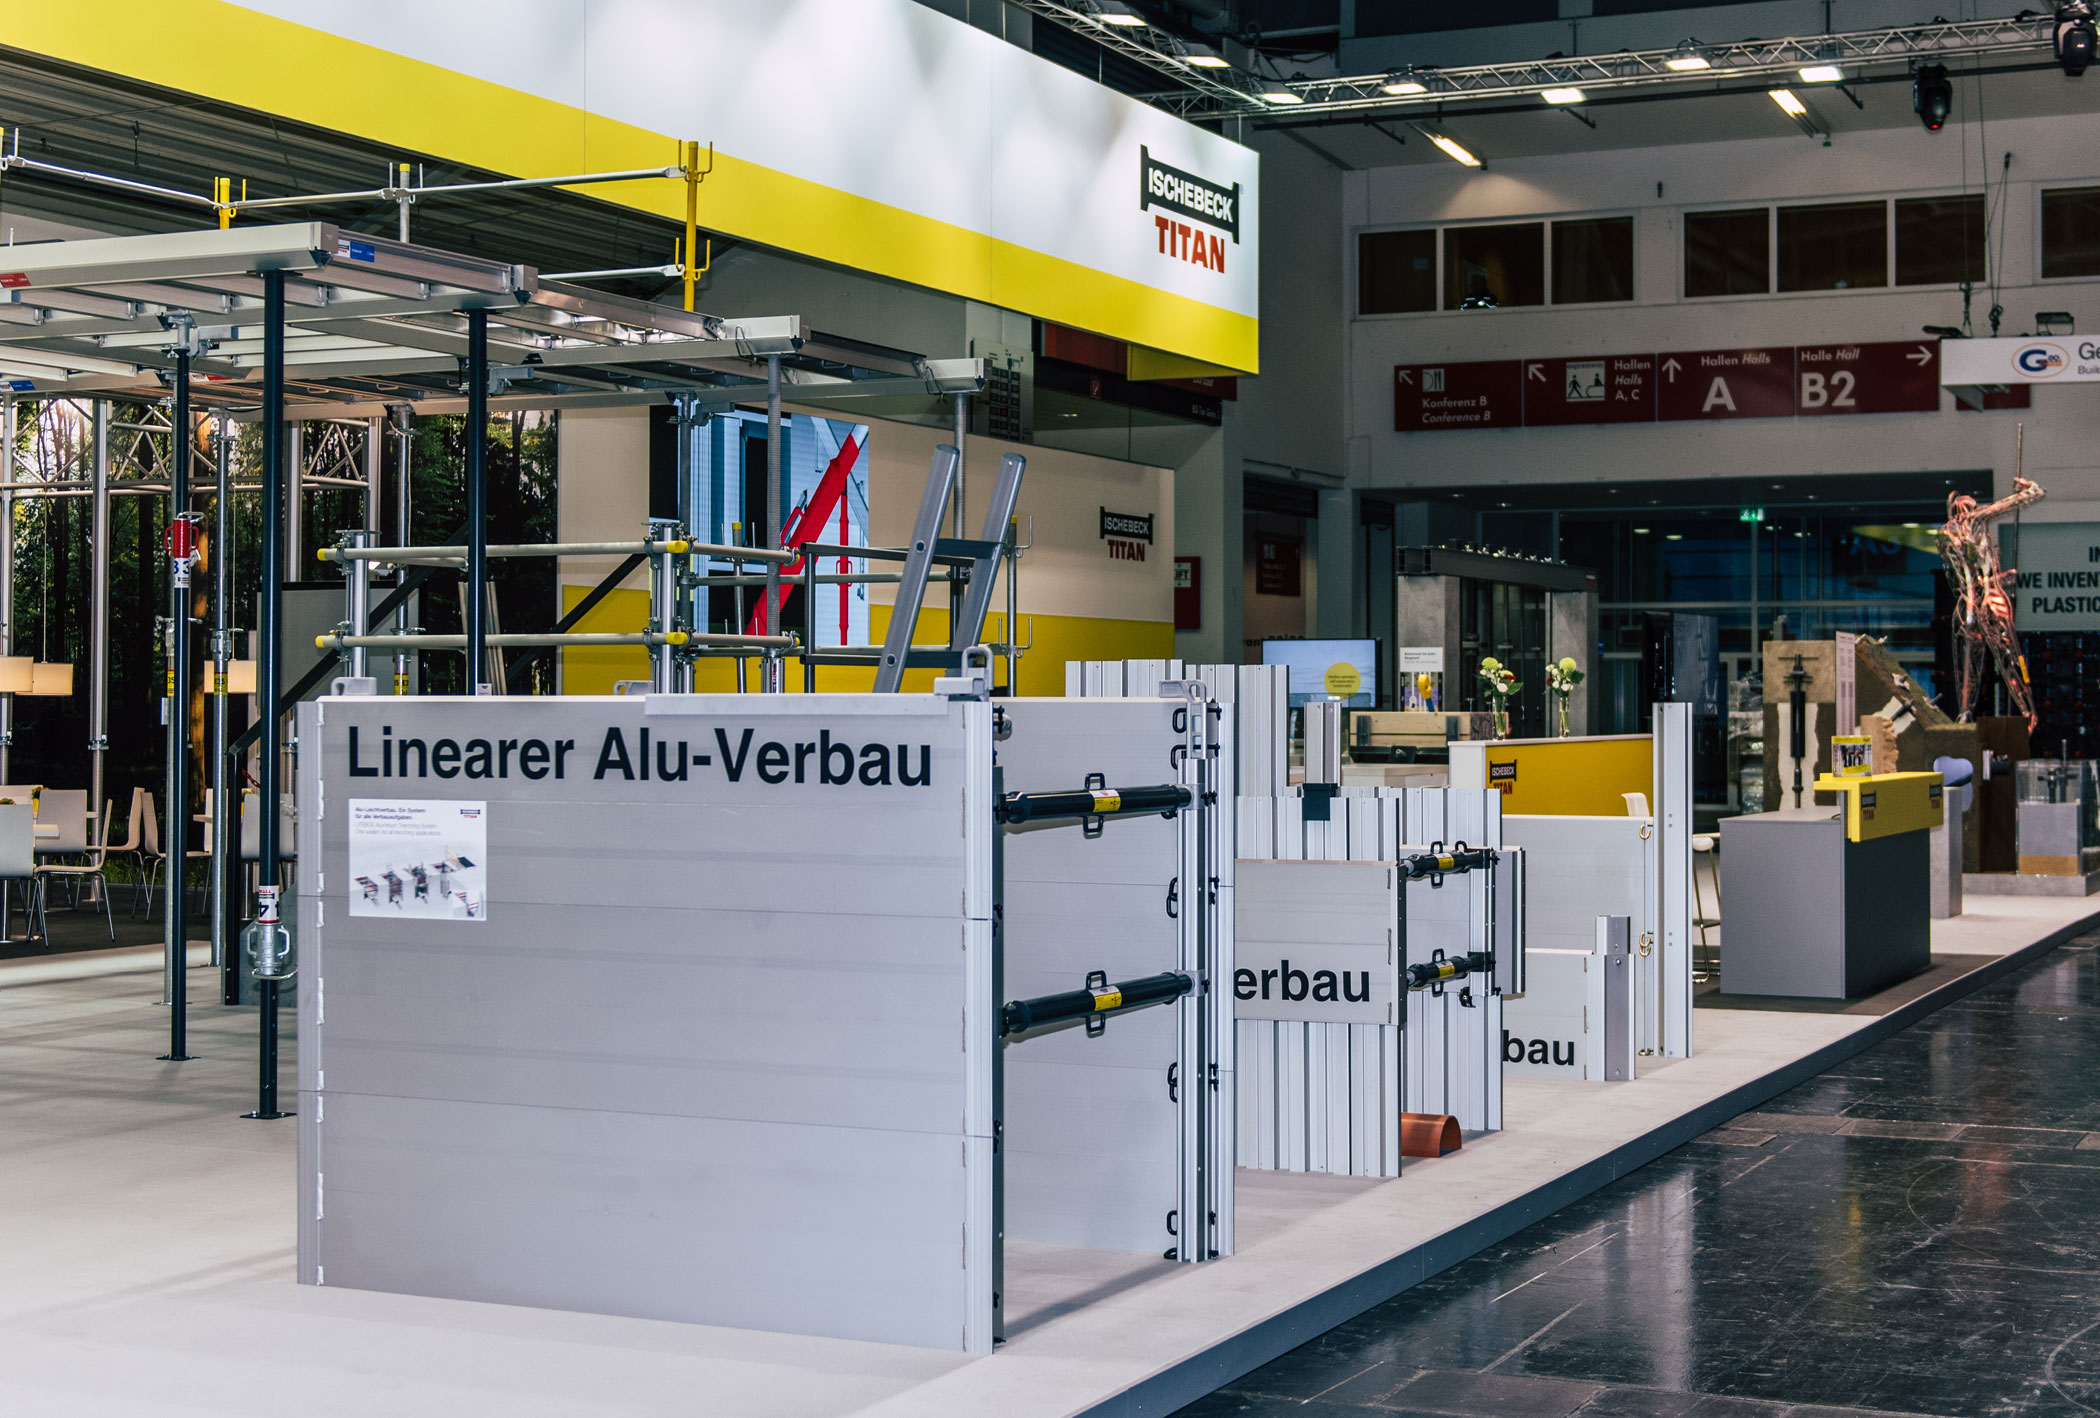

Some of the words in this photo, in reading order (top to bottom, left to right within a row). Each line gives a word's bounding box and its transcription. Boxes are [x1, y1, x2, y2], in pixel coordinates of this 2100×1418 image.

[1148, 167, 1234, 224] ISCHEBECK
[1155, 215, 1225, 274] TITAN
[1701, 354, 1738, 367] Hallen
[1741, 352, 1771, 365] Halls
[1801, 350, 1832, 363] Halle
[1835, 348, 1860, 360] Hall
[1614, 359, 1651, 371] Hallen
[1615, 373, 1642, 386] Halls
[1615, 390, 1628, 402] A,
[1631, 389, 1640, 400] C
[1702, 376, 1737, 412] A
[1801, 370, 1856, 408] B2
[1422, 397, 1476, 409] Konferenz
[1480, 395, 1487, 406] B
[1422, 411, 1481, 424] Conference
[1483, 410, 1491, 421] B
[1104, 516, 1149, 535] ISCHEBECK
[1107, 539, 1145, 562] TITAN
[1174, 569, 1189, 580] IFT
[2016, 572, 2042, 589] WE
[2048, 571, 2100, 588] INVEN
[348, 726, 574, 779] Linearer
[593, 727, 932, 787] Alu-Verbau
[1233, 959, 1370, 1003] erbau
[1502, 1029, 1575, 1066] bau
